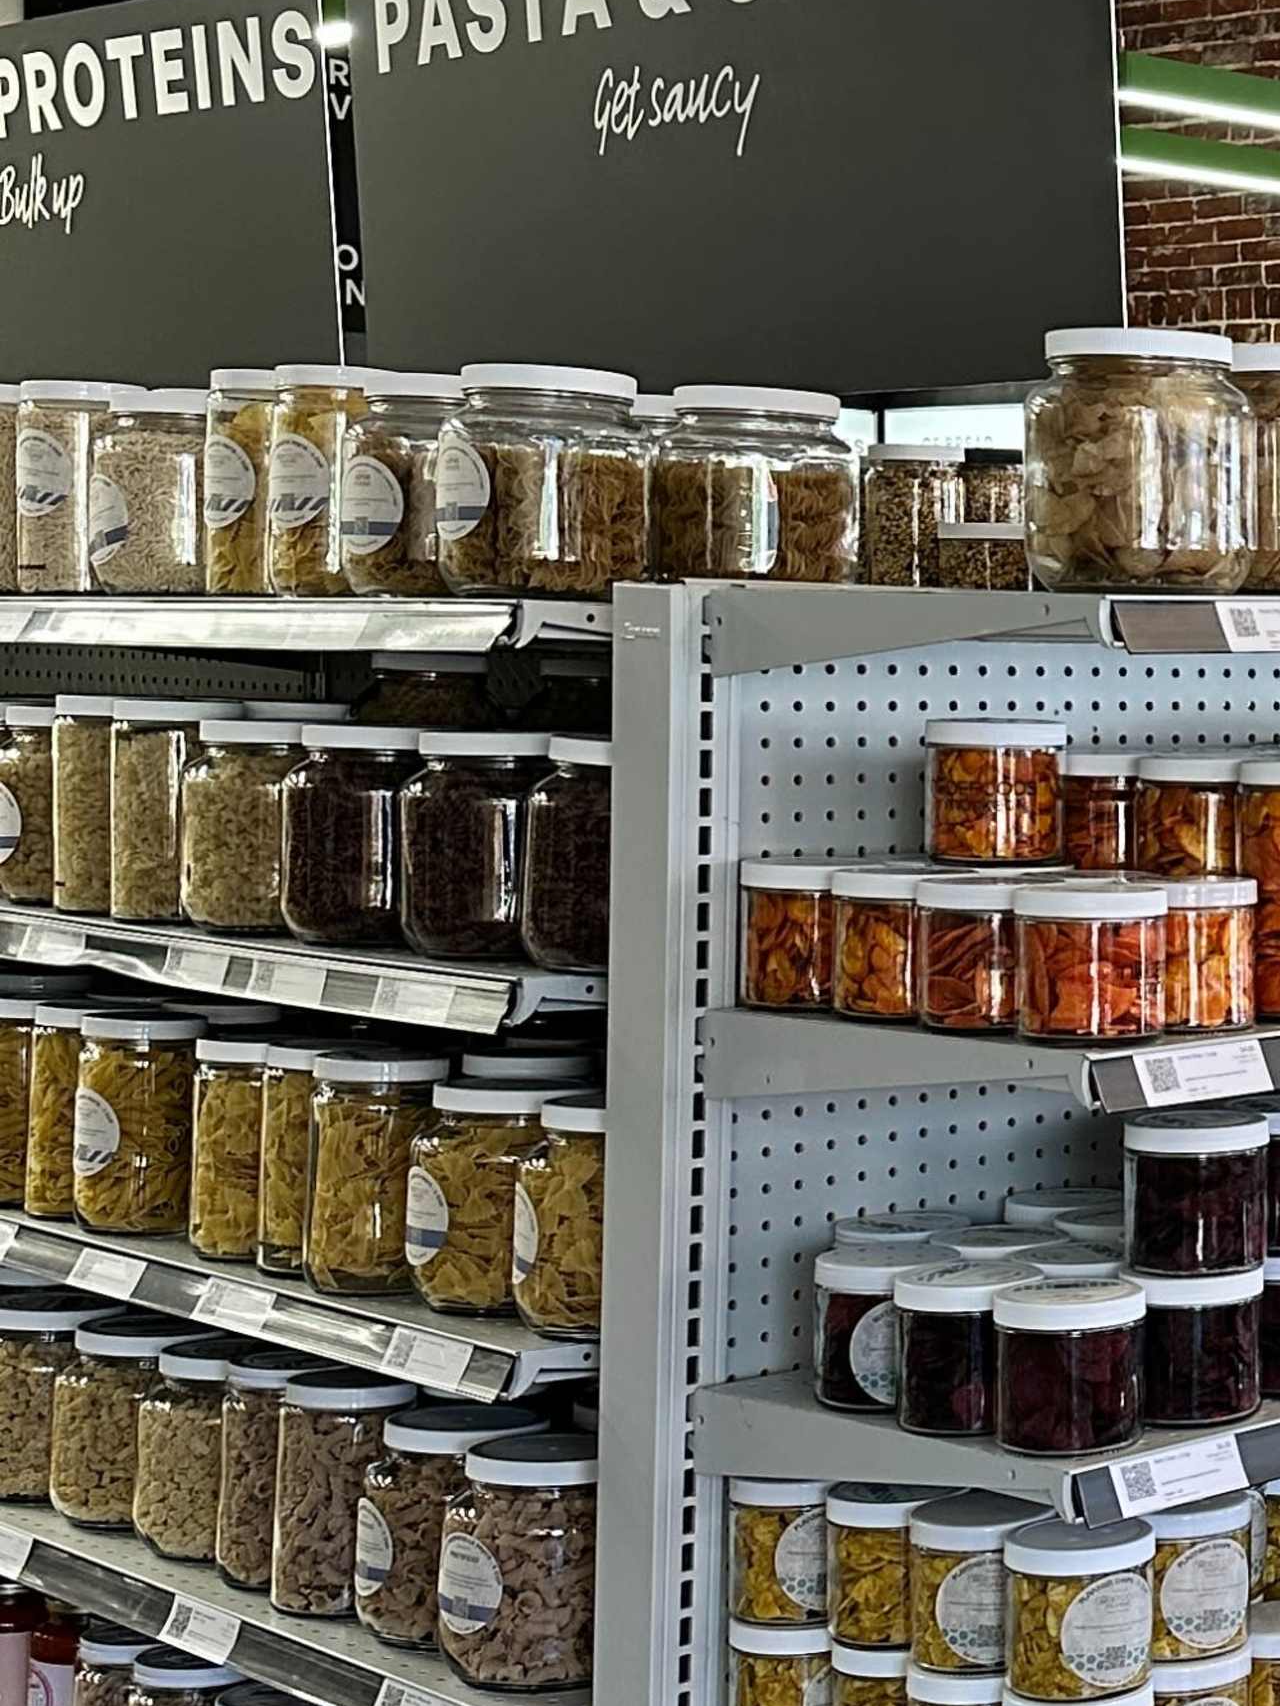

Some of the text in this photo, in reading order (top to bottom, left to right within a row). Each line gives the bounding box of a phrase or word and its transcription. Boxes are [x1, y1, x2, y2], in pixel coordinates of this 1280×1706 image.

[0, 10, 315, 139] PROTEINS
[594, 64, 760, 157] Get saucy
[0, 153, 84, 235] Bulk up
